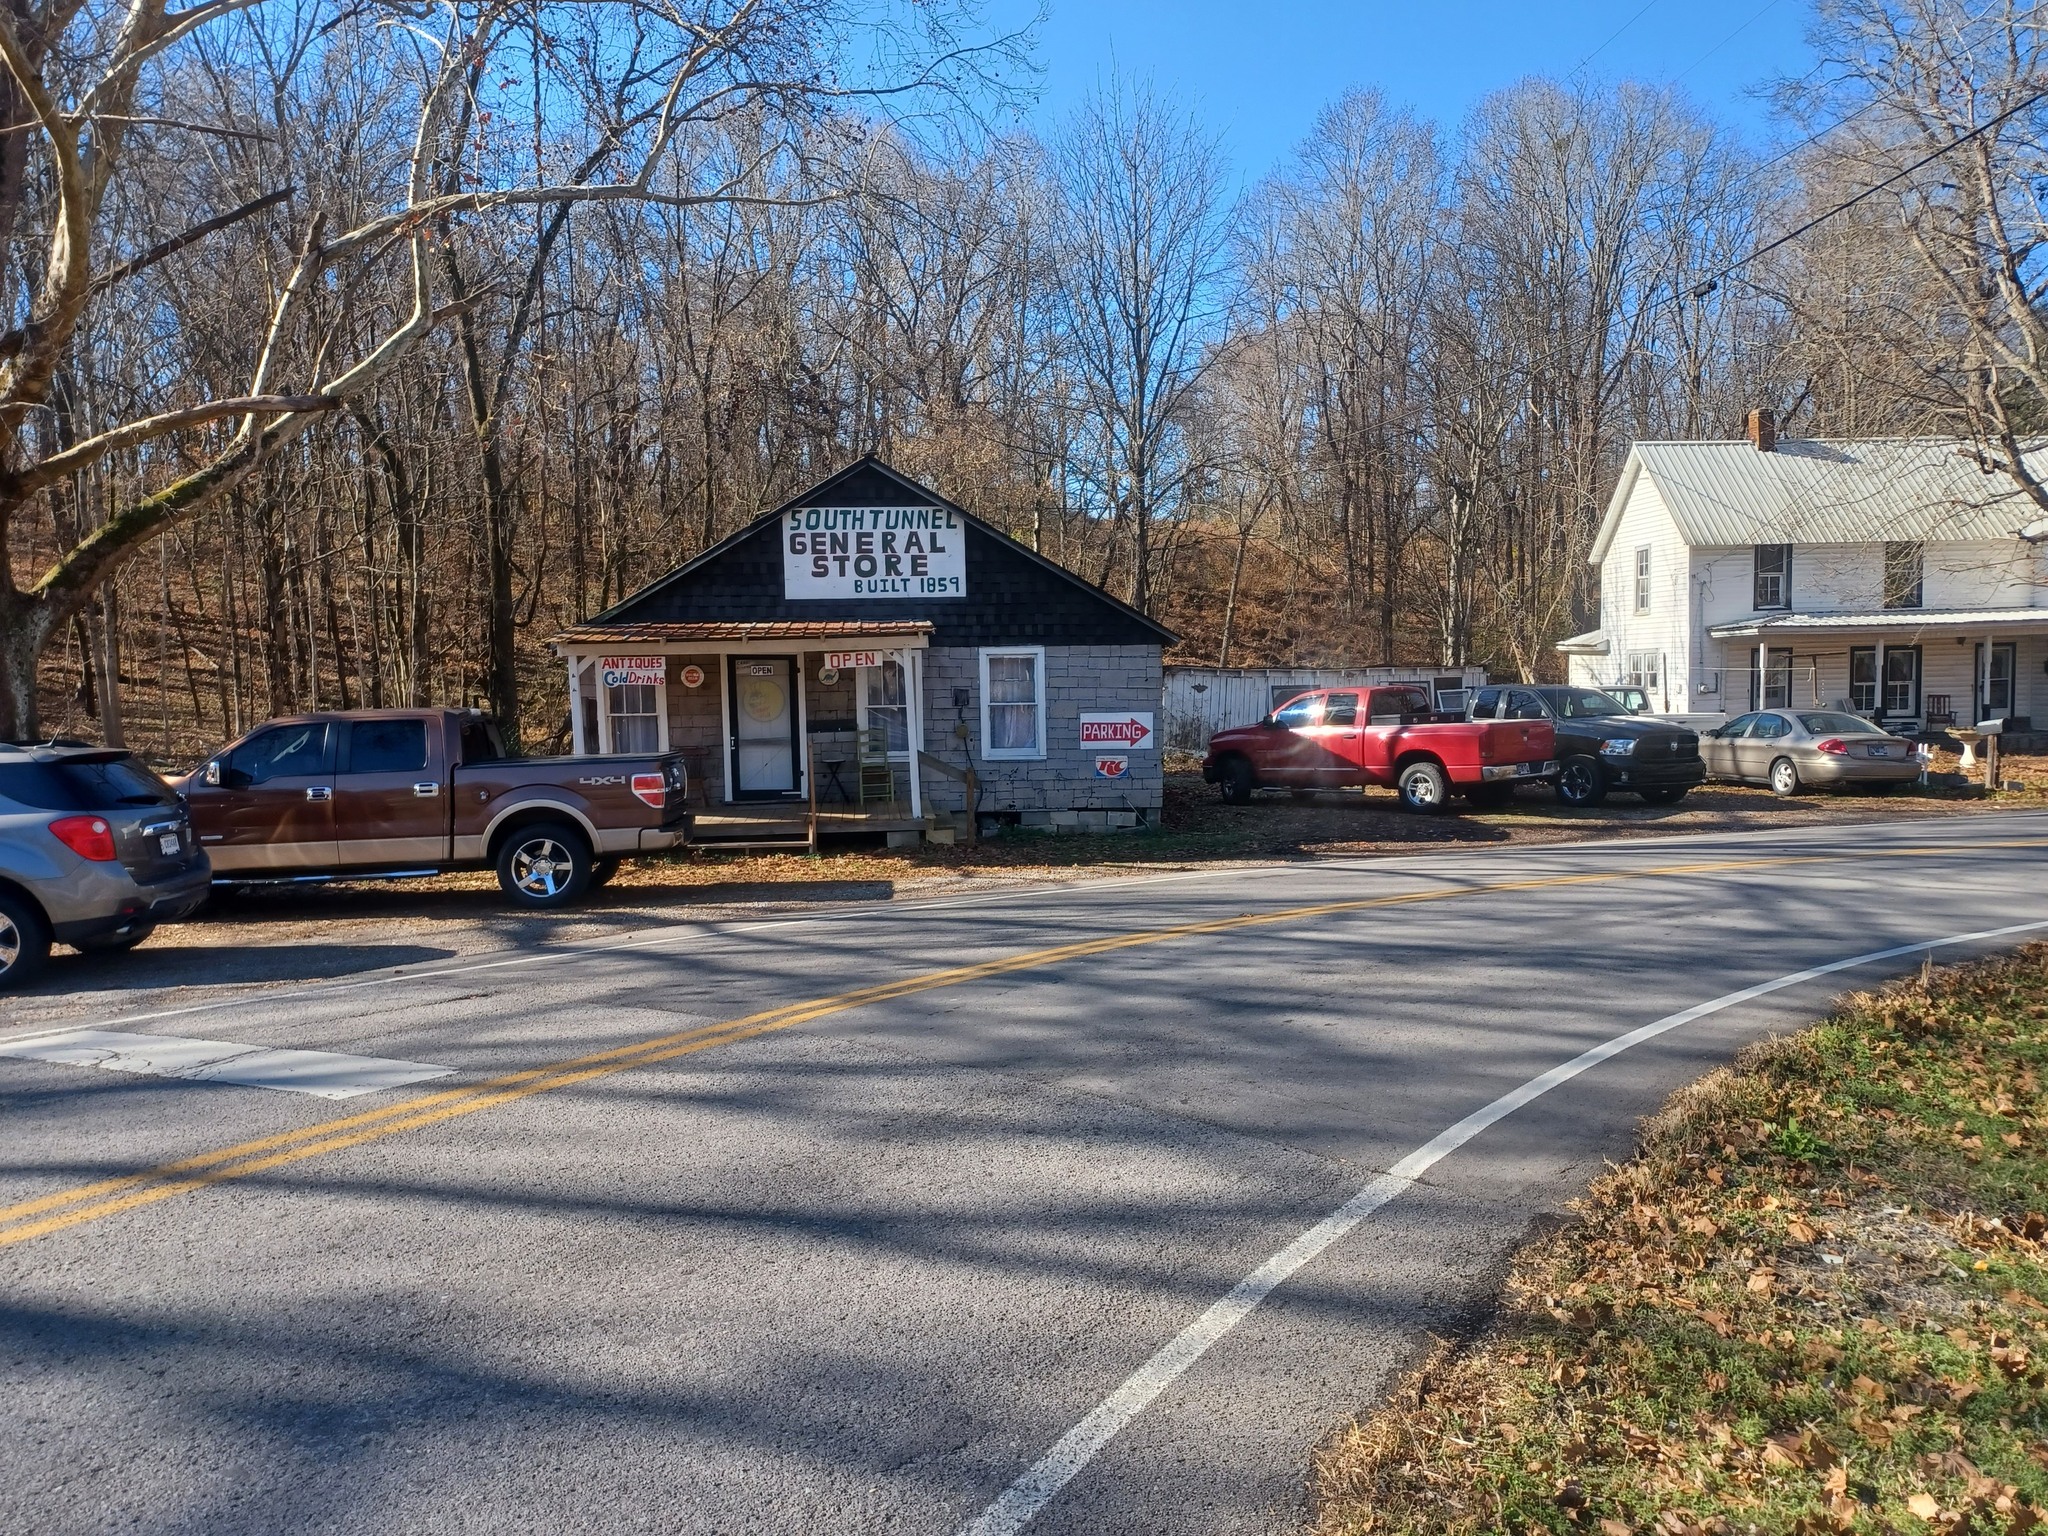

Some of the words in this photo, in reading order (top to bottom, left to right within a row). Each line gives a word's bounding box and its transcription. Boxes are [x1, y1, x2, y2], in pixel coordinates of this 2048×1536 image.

[789, 508, 865, 531] SOUTH
[869, 508, 958, 530] TUNNEL
[789, 531, 947, 555] GENERAL
[811, 554, 929, 578] STORE
[854, 578, 911, 594] BUILT
[920, 576, 960, 594] 1859
[601, 657, 663, 670] ANTIQUES
[830, 652, 876, 668] OPEN
[752, 666, 773, 675] OPEN
[1083, 724, 1141, 739] PARKING
[1098, 760, 1126, 776] RC
